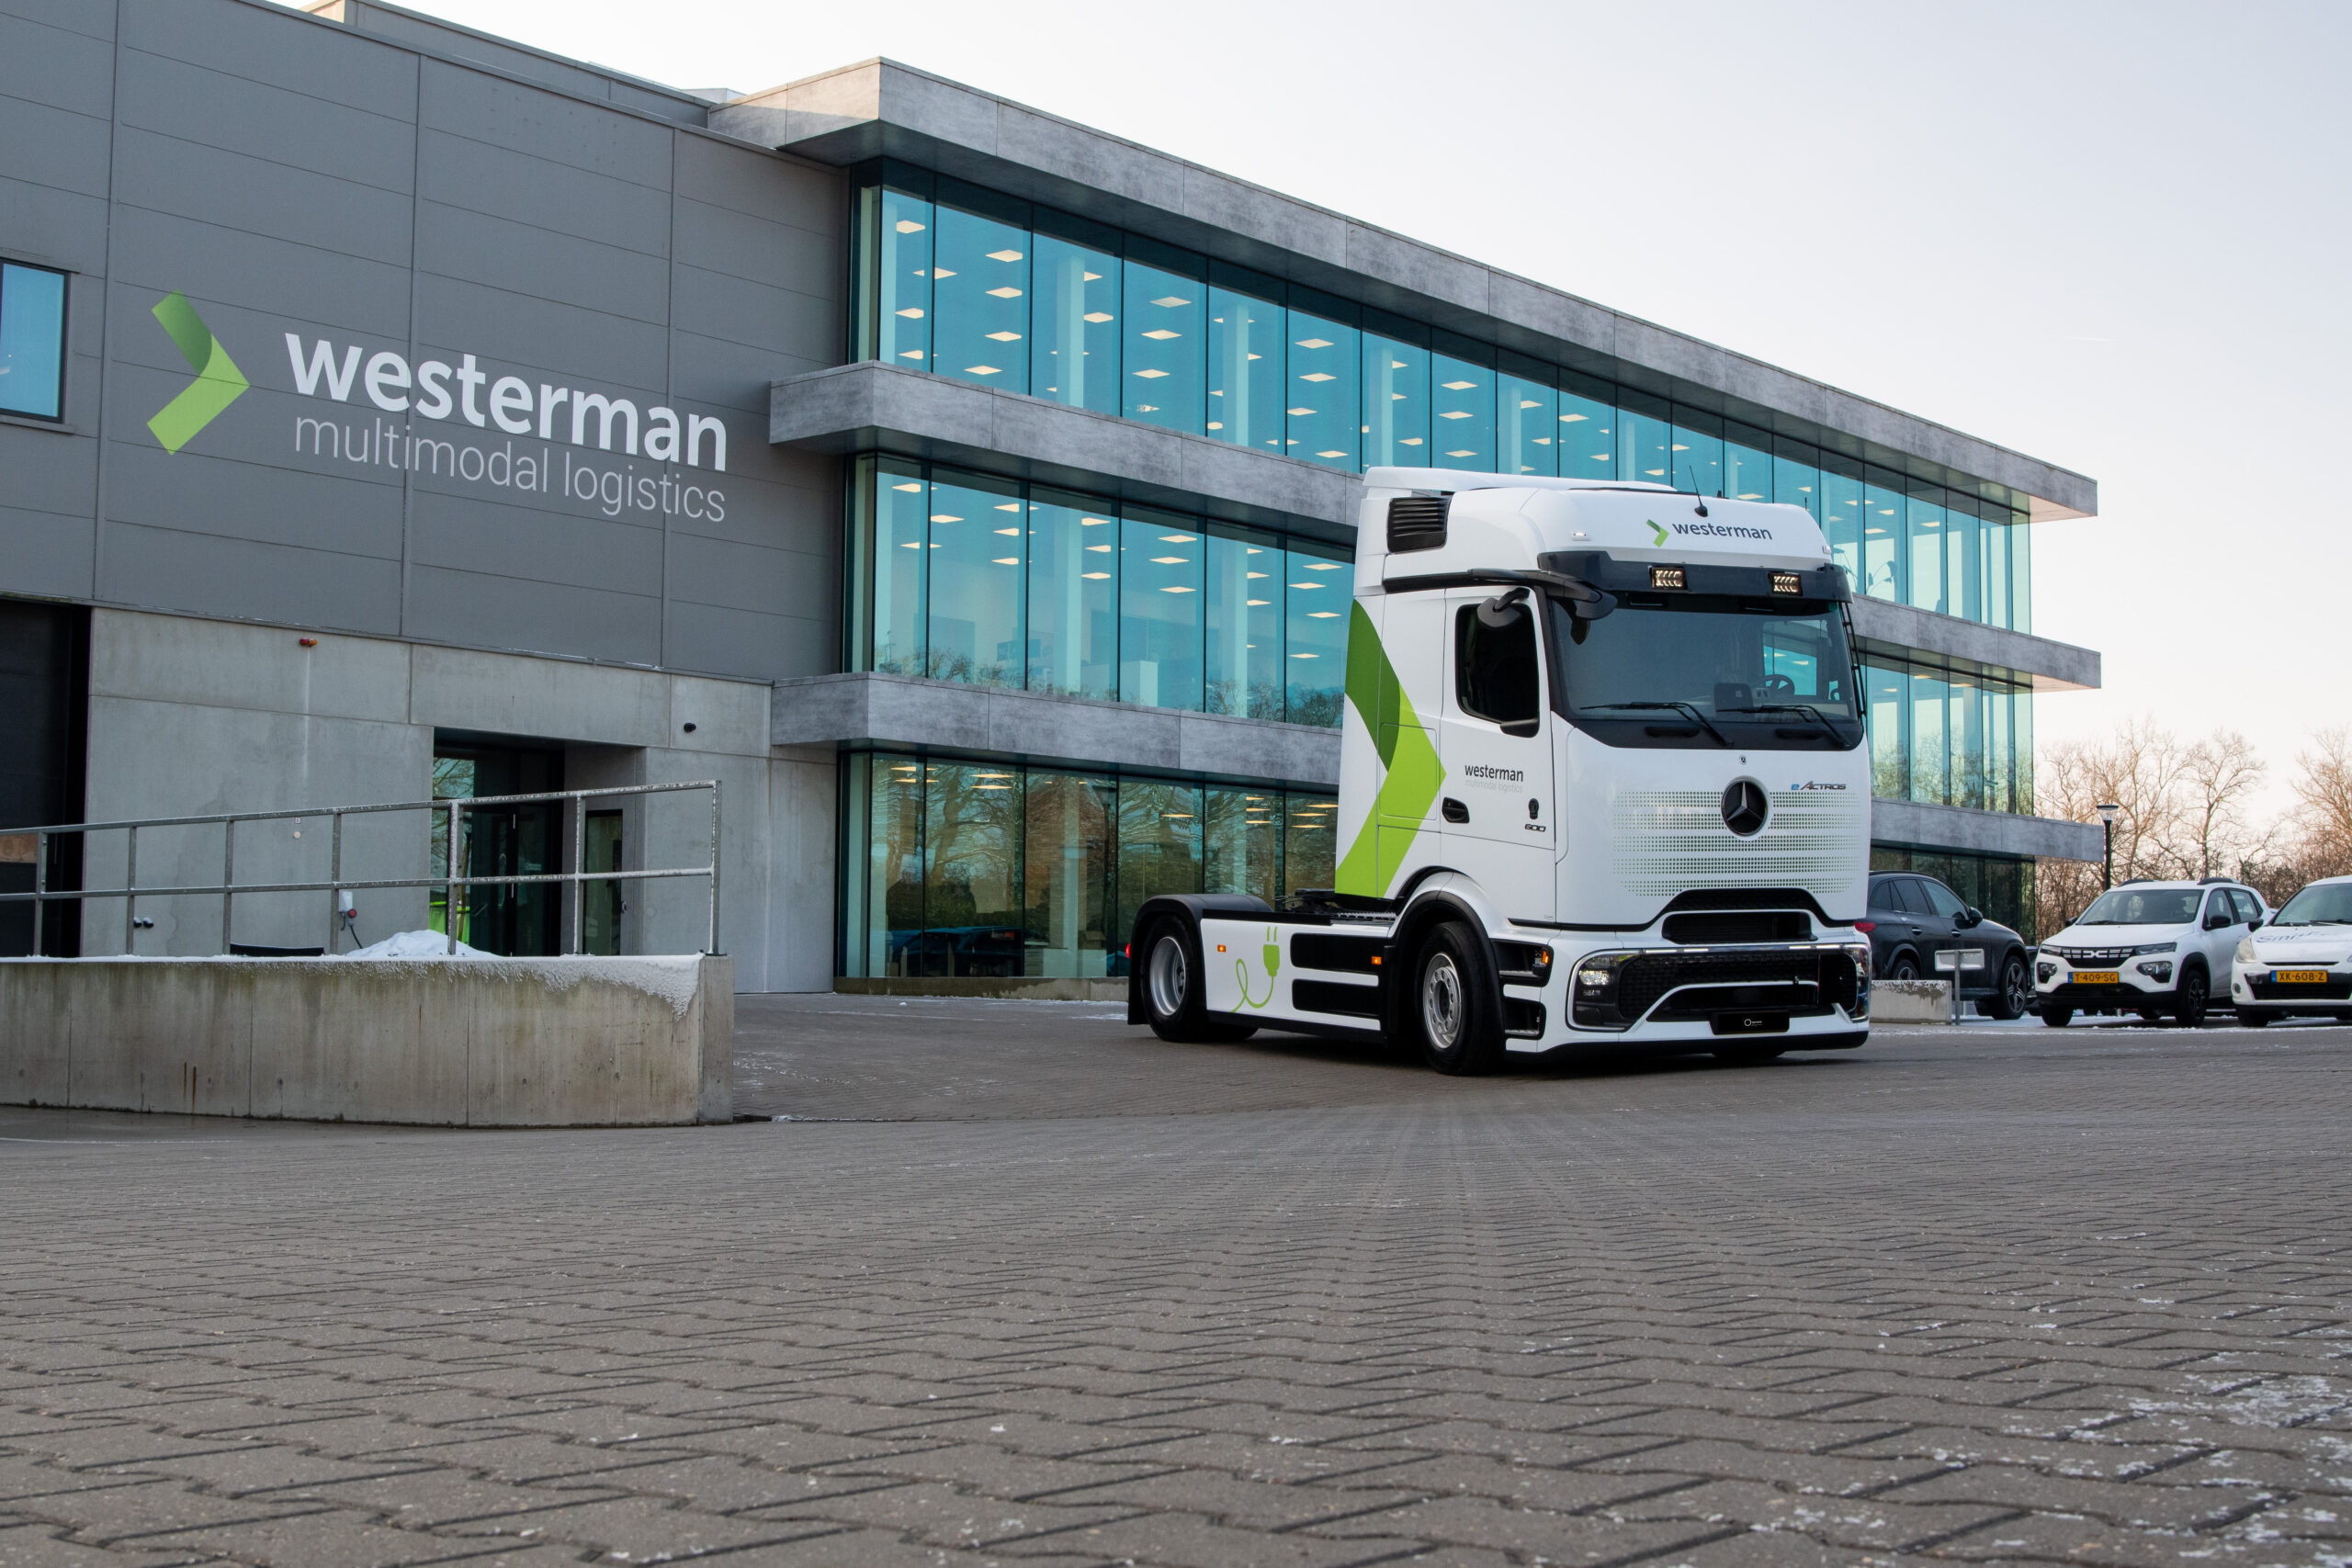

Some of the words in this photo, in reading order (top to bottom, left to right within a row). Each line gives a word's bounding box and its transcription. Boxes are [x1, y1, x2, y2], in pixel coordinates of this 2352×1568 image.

[285, 333, 727, 471] westerman
[296, 416, 549, 493] multimodal
[565, 452, 725, 523] logistics
[1672, 523, 1772, 540] westerman
[1464, 764, 1523, 782] westerman
[1524, 823, 1546, 832] 600
[2075, 974, 2116, 982] T-409-SG
[2279, 973, 2324, 981] XK-608-Z
